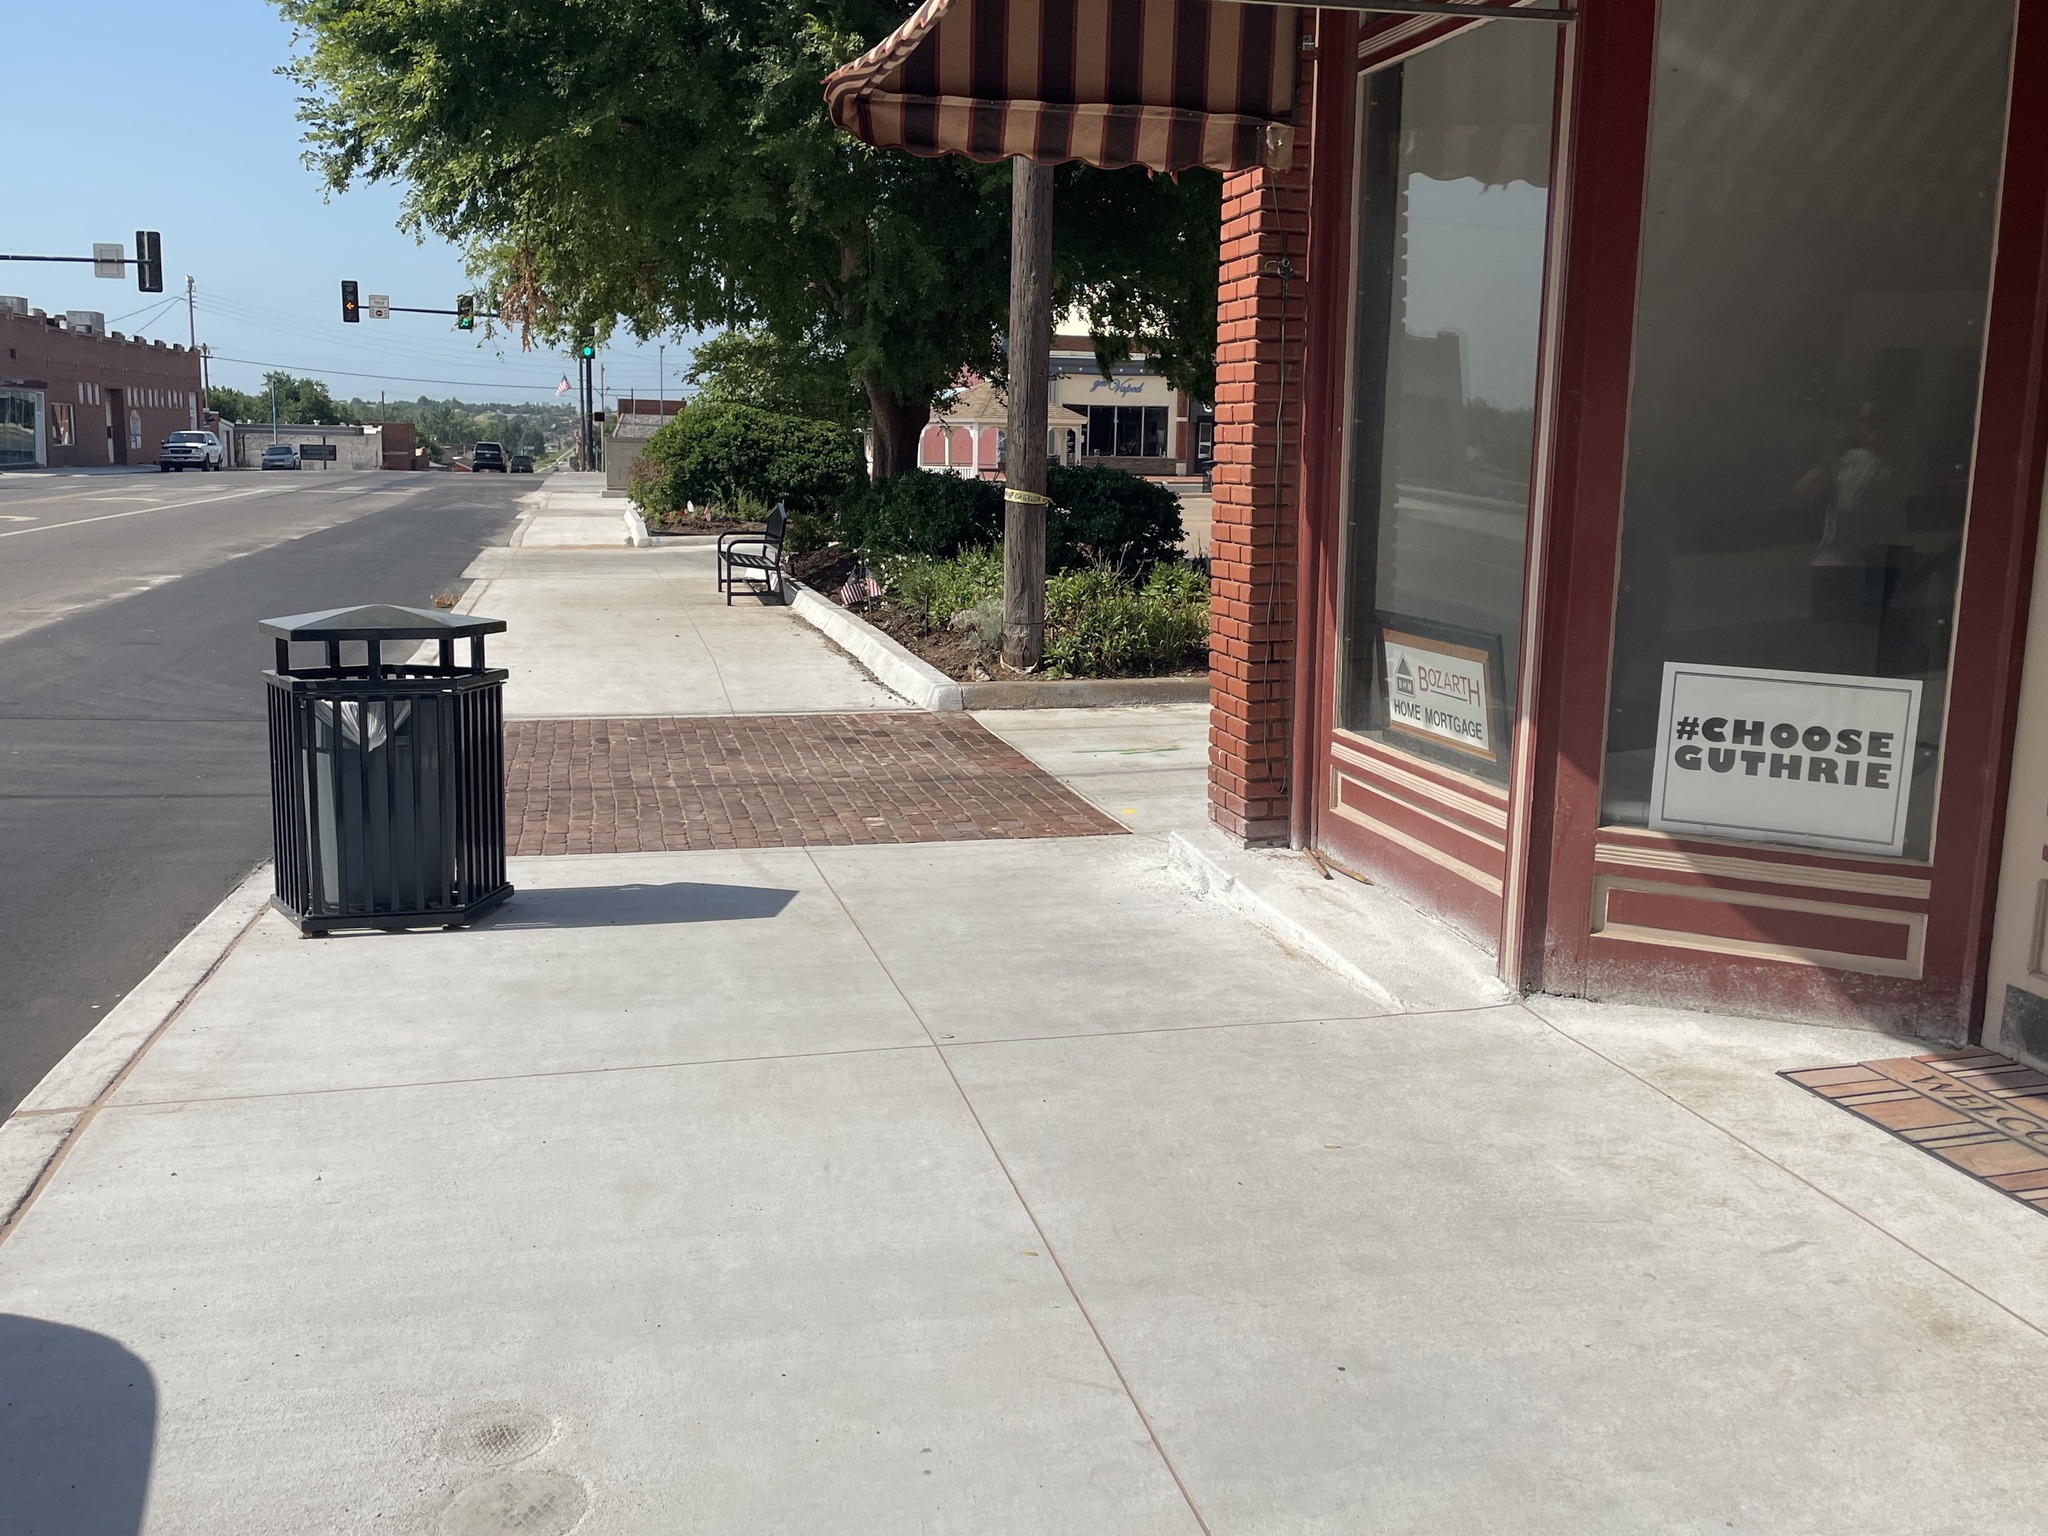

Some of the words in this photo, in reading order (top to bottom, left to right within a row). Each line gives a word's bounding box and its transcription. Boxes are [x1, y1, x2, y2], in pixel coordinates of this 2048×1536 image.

[1109, 378, 1144, 398] Vaped
[1418, 665, 1481, 707] BOZARTH
[1394, 698, 1422, 721] HOME
[1425, 707, 1483, 740] MORTGAGE
[1676, 716, 1894, 759] #CHOOSE
[1674, 744, 1892, 789] GUTHRIE
